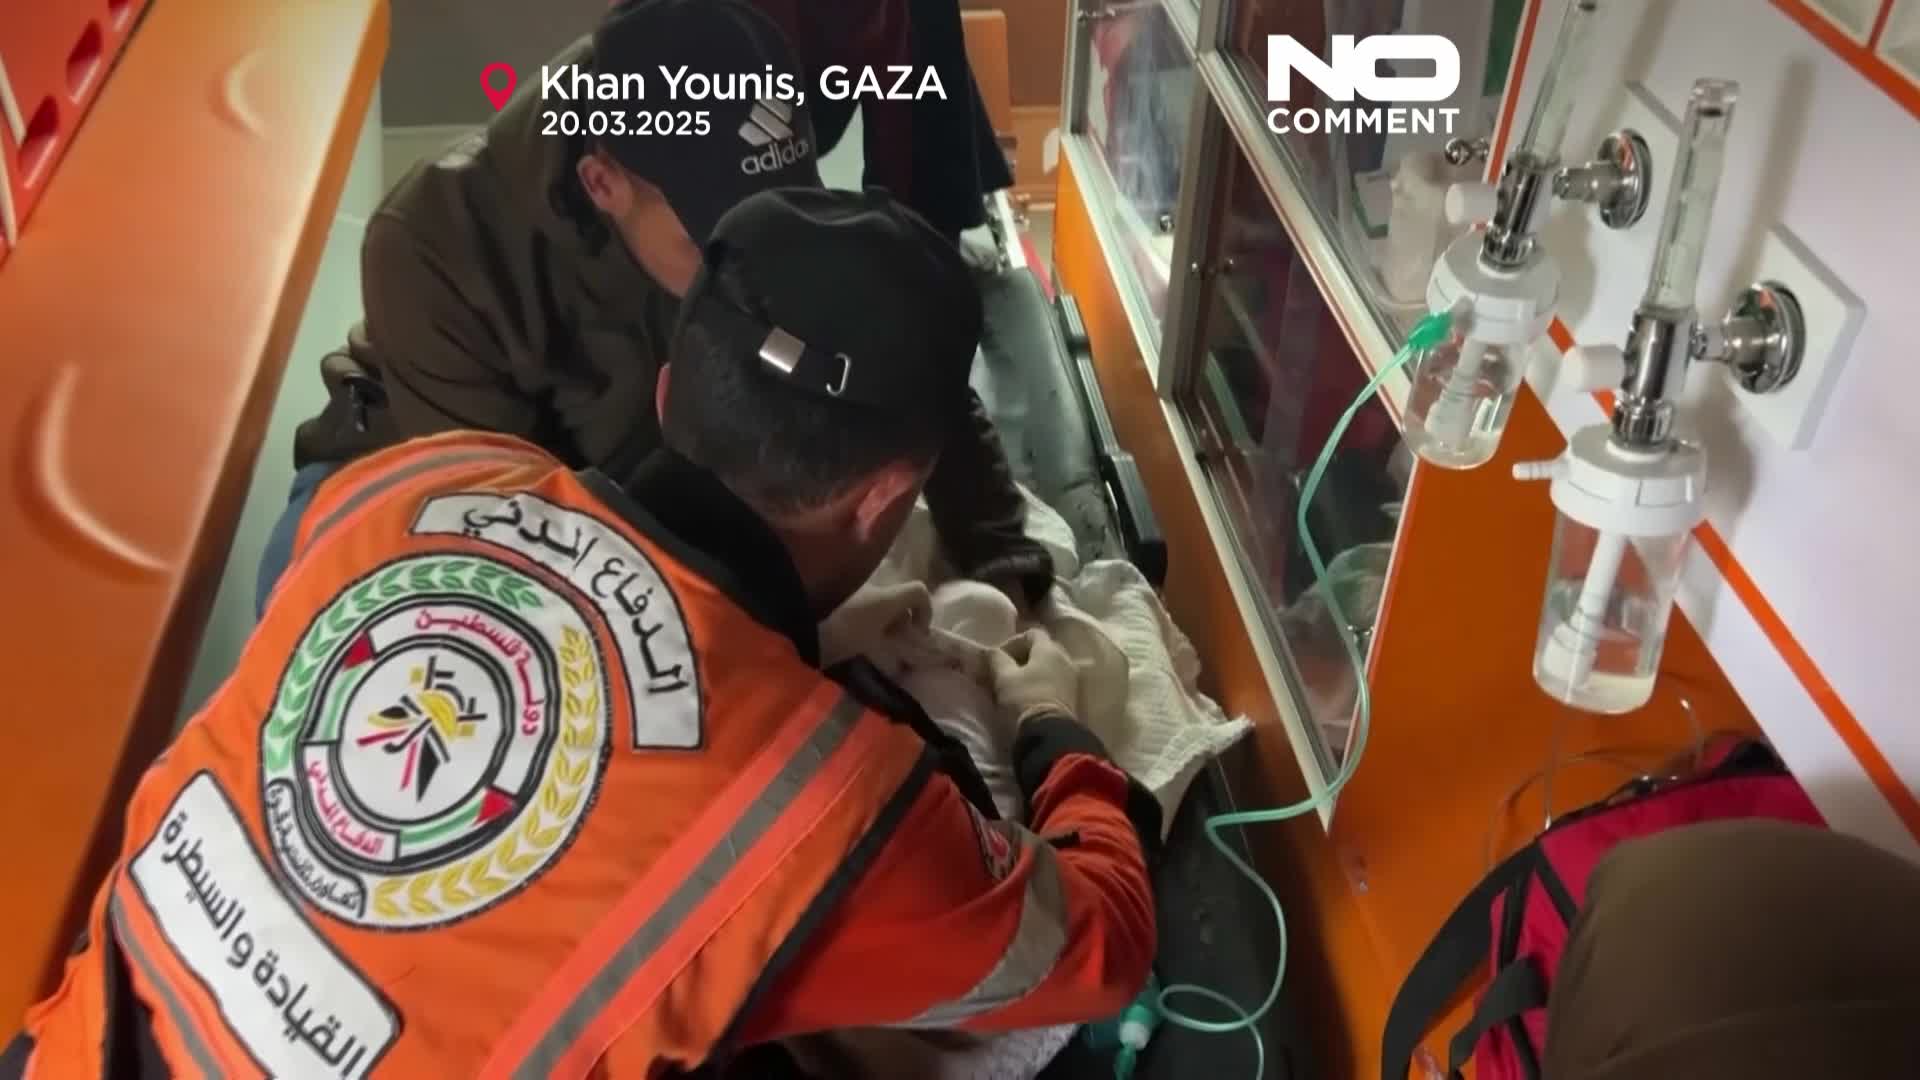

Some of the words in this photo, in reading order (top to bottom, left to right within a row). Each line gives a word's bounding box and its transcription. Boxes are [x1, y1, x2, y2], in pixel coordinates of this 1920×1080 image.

[740, 138, 809, 175] adida
[463, 500, 598, 568] المدني
[415, 608, 521, 657] فلسطين
[591, 557, 690, 695] الدفاع
[252, 949, 367, 1079] القيادة
